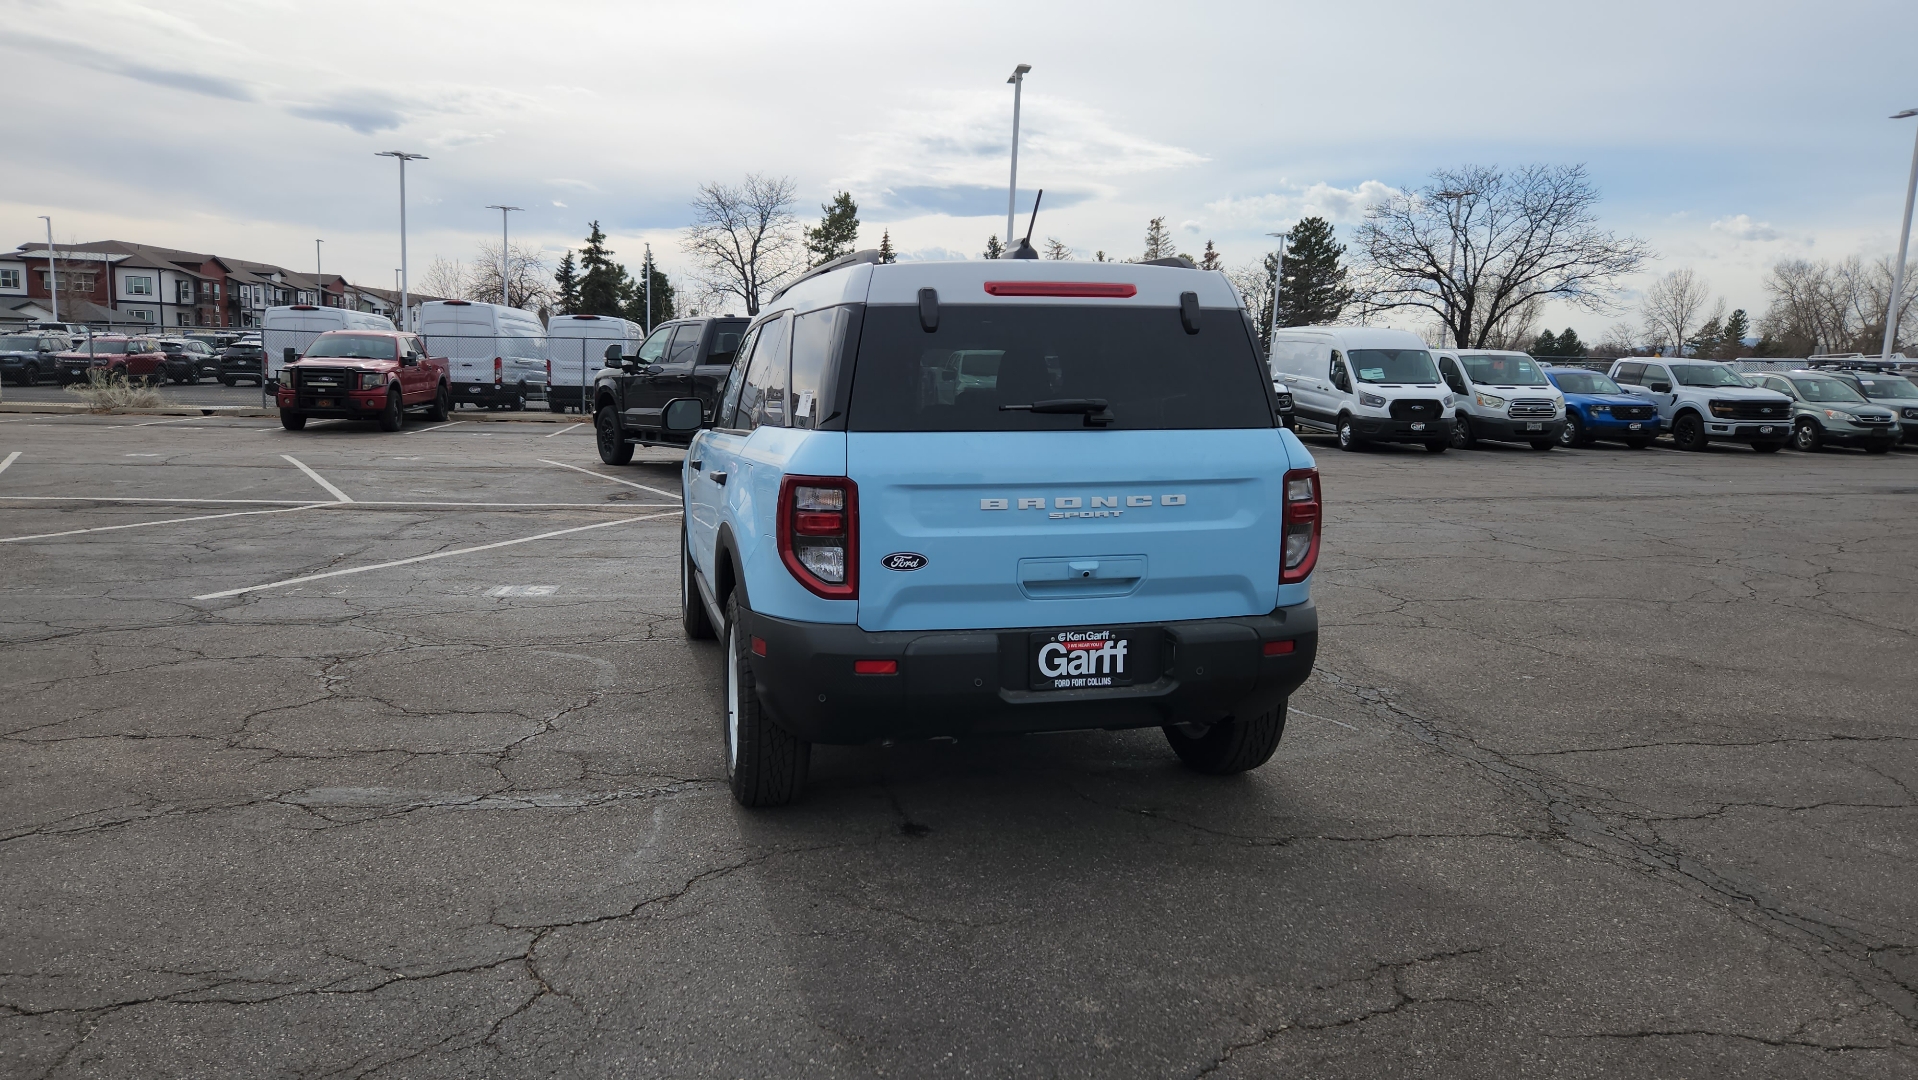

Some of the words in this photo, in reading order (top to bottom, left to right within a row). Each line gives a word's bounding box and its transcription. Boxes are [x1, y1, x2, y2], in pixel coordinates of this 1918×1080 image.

[980, 494, 1187, 511] BRONCO
[1048, 510, 1124, 519] SPORT
[890, 555, 920, 568] Ford
[1066, 632, 1085, 641] Ken
[1086, 631, 1109, 640] Garff
[1038, 640, 1128, 678] Garff
[1054, 679, 1071, 688] FORD
[1071, 678, 1087, 687] FORT
[1087, 677, 1112, 686] COLLINS
